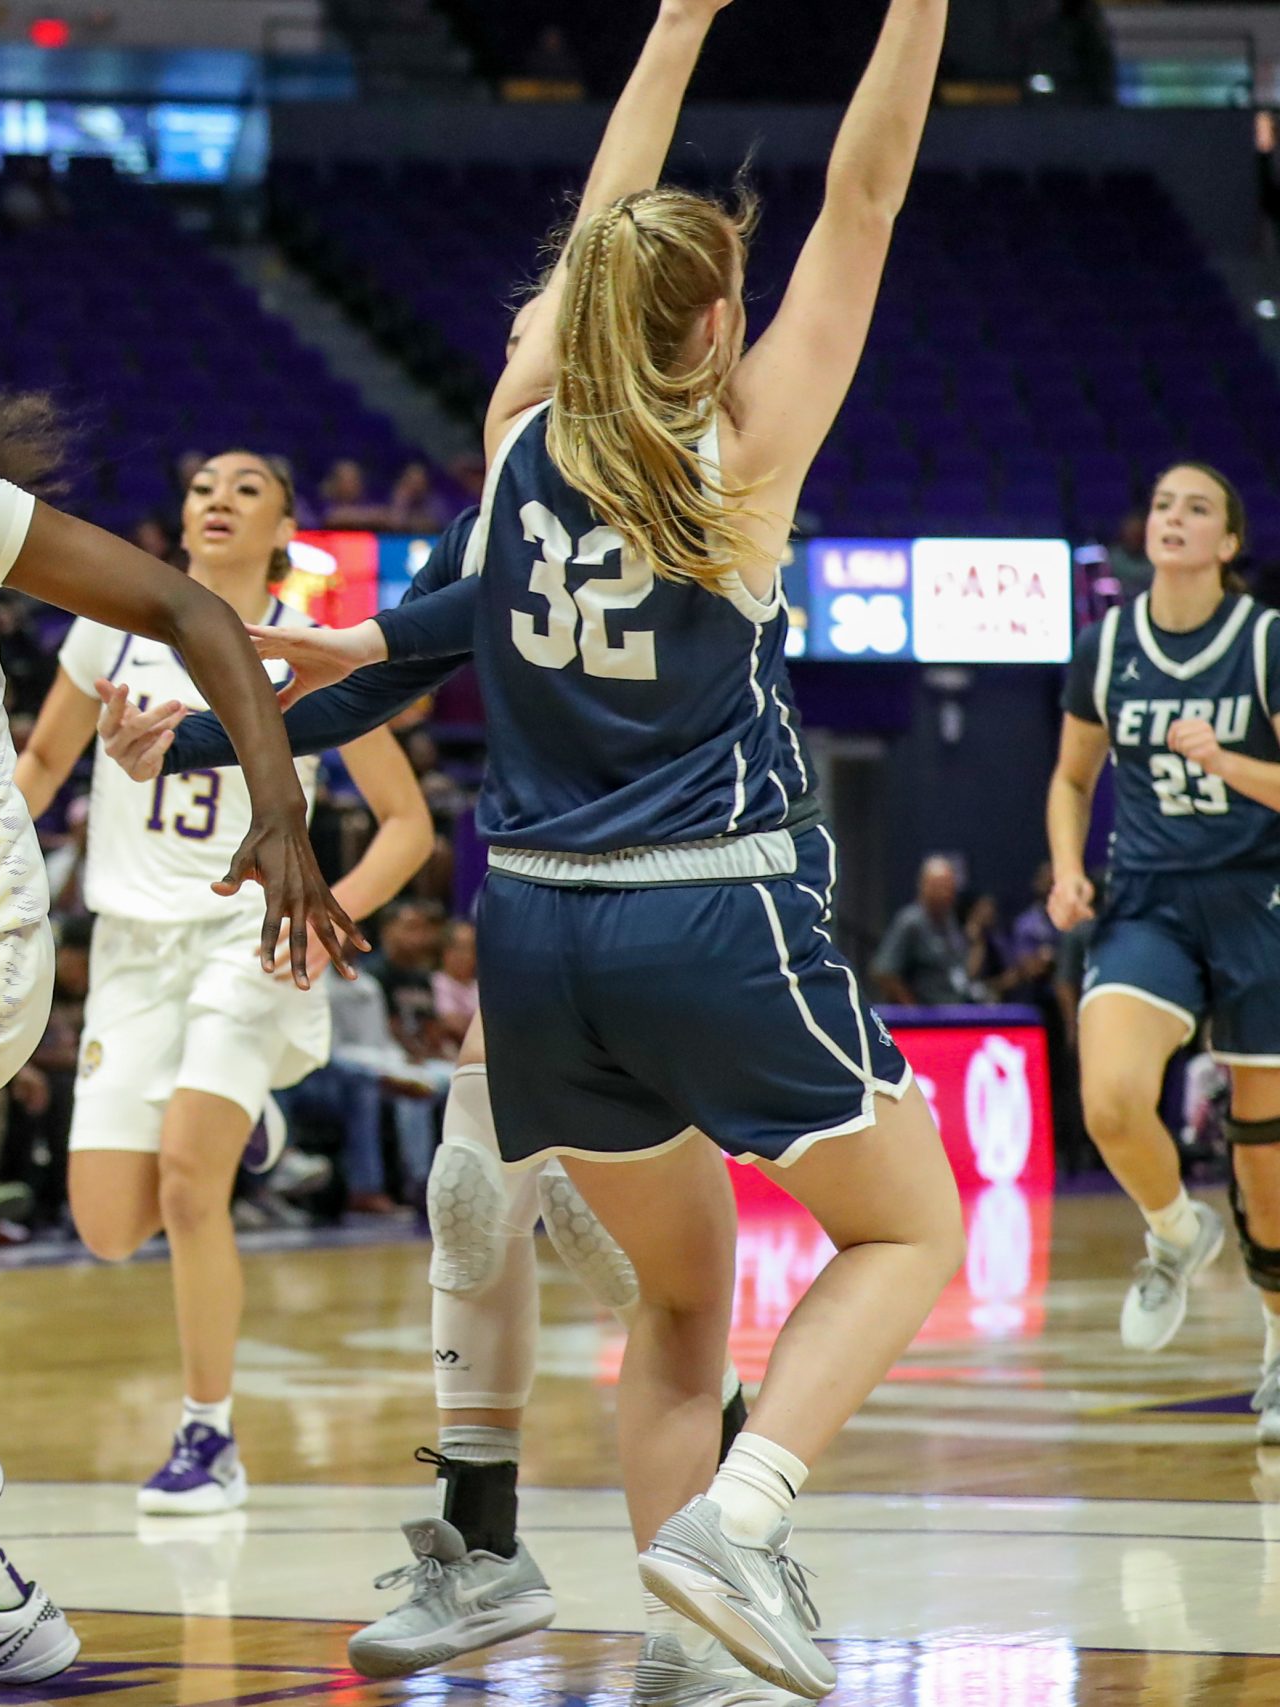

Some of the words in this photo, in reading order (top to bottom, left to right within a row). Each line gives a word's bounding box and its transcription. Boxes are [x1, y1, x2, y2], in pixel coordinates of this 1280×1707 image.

[510, 500, 657, 680] 32
[145, 768, 222, 840] 13
[1149, 753, 1229, 816] 23
